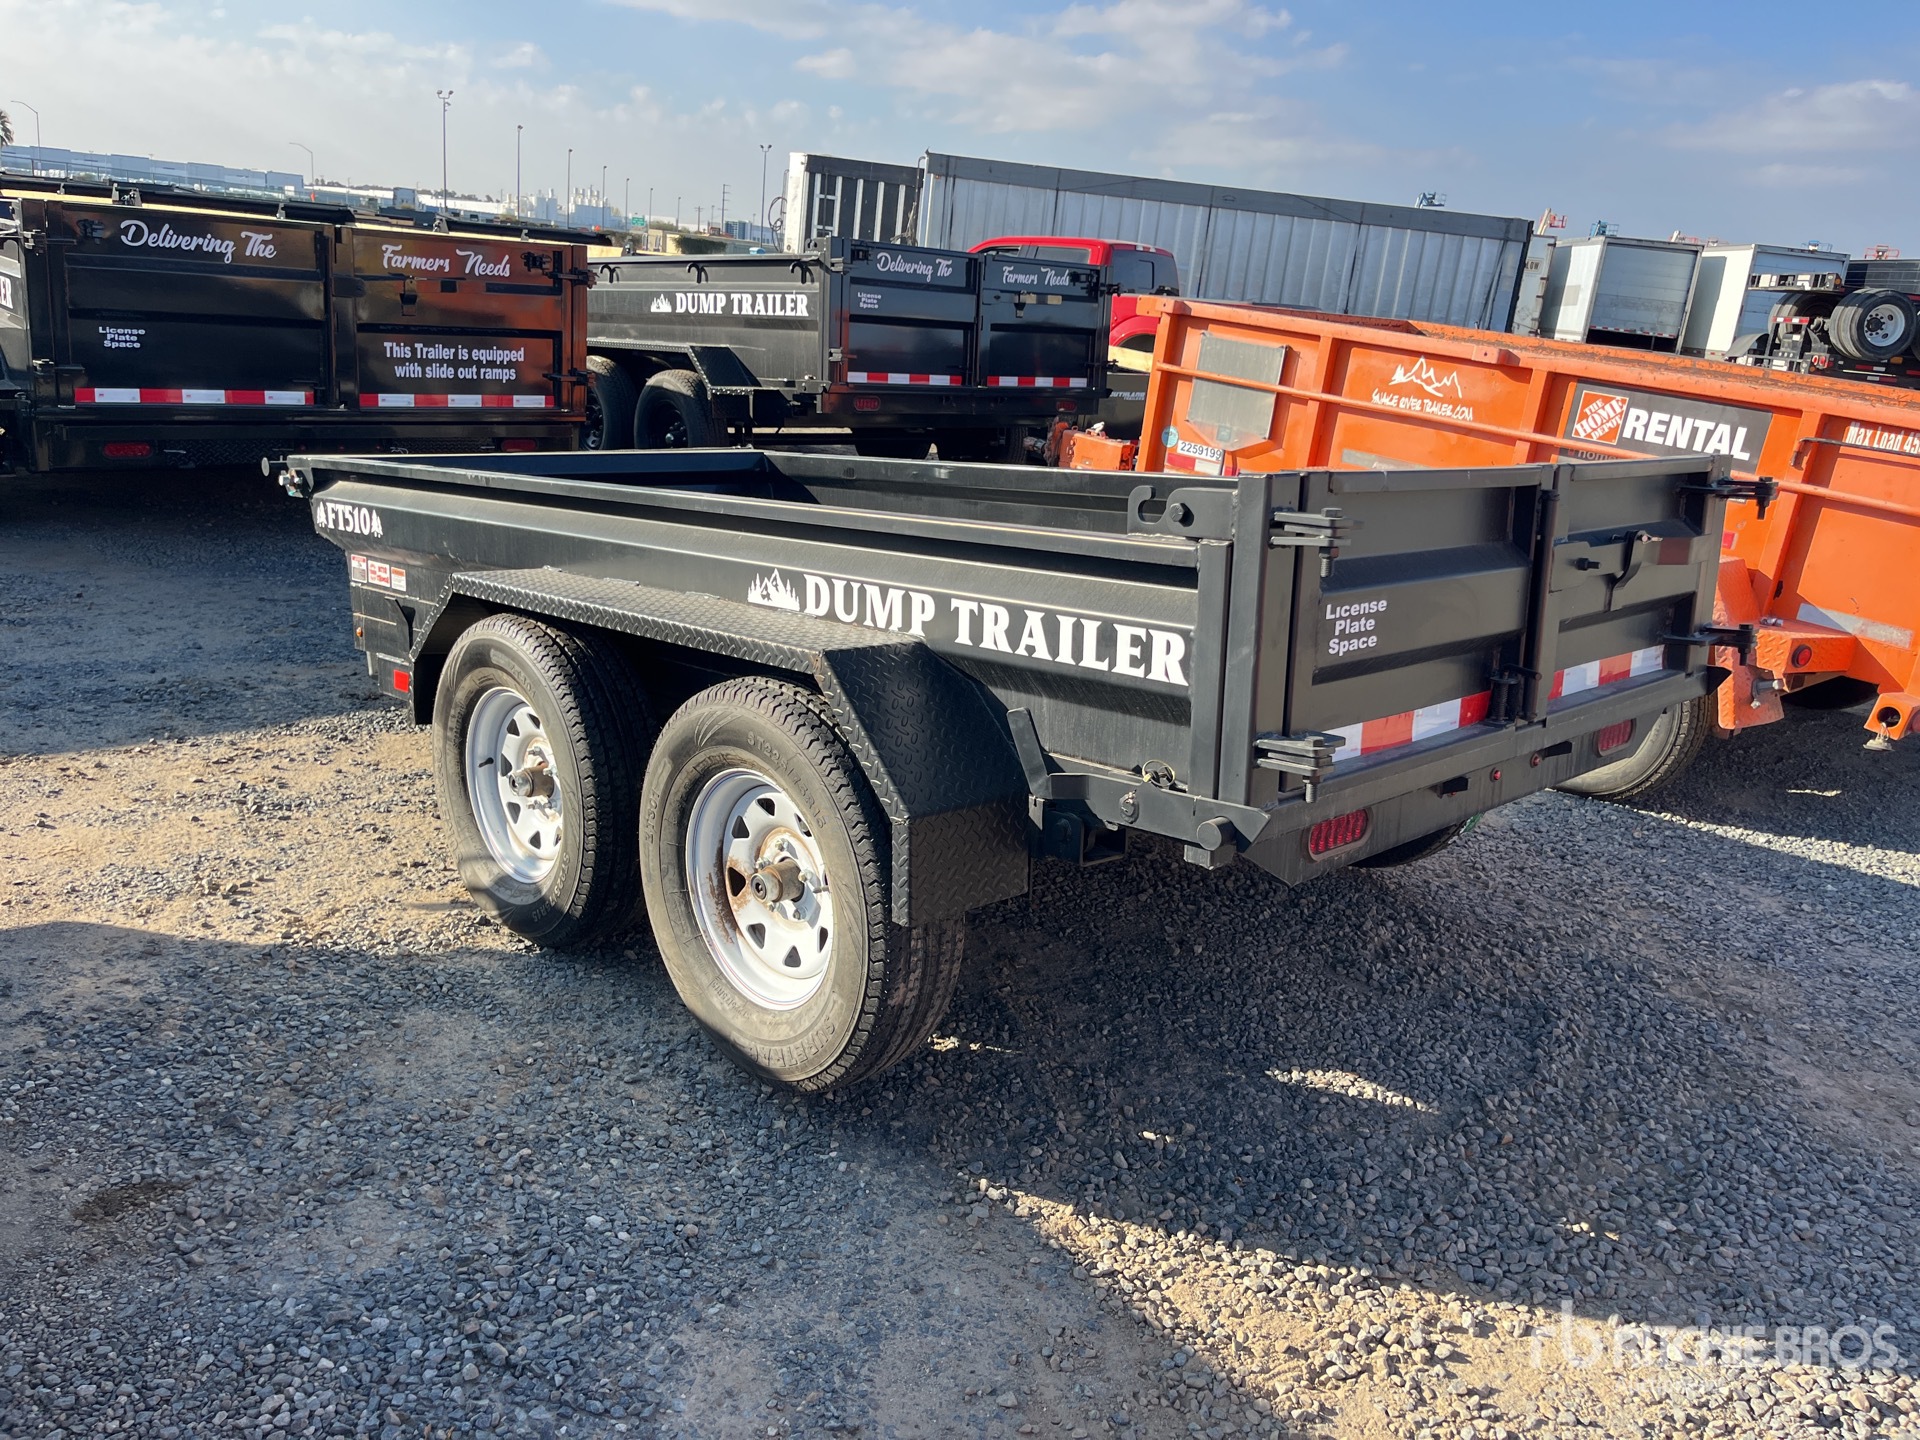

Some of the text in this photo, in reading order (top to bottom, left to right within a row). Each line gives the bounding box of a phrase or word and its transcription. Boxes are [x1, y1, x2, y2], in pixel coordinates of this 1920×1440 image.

[120, 219, 277, 264] Delivering The
[381, 244, 510, 277] Farmers Needs
[876, 252, 953, 283] Delivering The
[1002, 266, 1070, 287] Farmers Needs
[675, 291, 809, 317] DUMP TRAILER
[857, 291, 882, 299] License
[98, 326, 146, 335] License
[106, 333, 138, 341] Plate
[103, 340, 141, 349] Space
[383, 341, 525, 365] This Trailer is equipped
[395, 362, 516, 384] with slide out ramps
[1575, 397, 1627, 438] HOME
[1583, 398, 1605, 416] THE
[1590, 415, 1621, 441] DEPOT
[1622, 407, 1750, 461] RENTAL
[1180, 441, 1222, 460] 2259199
[1873, 426, 1905, 451] Load
[1903, 432, 1920, 454] 45
[325, 502, 371, 536] FT510
[1325, 600, 1388, 620] License
[802, 573, 1190, 687] DUMP TRAILER
[1334, 617, 1376, 636] Plate
[1328, 635, 1377, 657] Space
